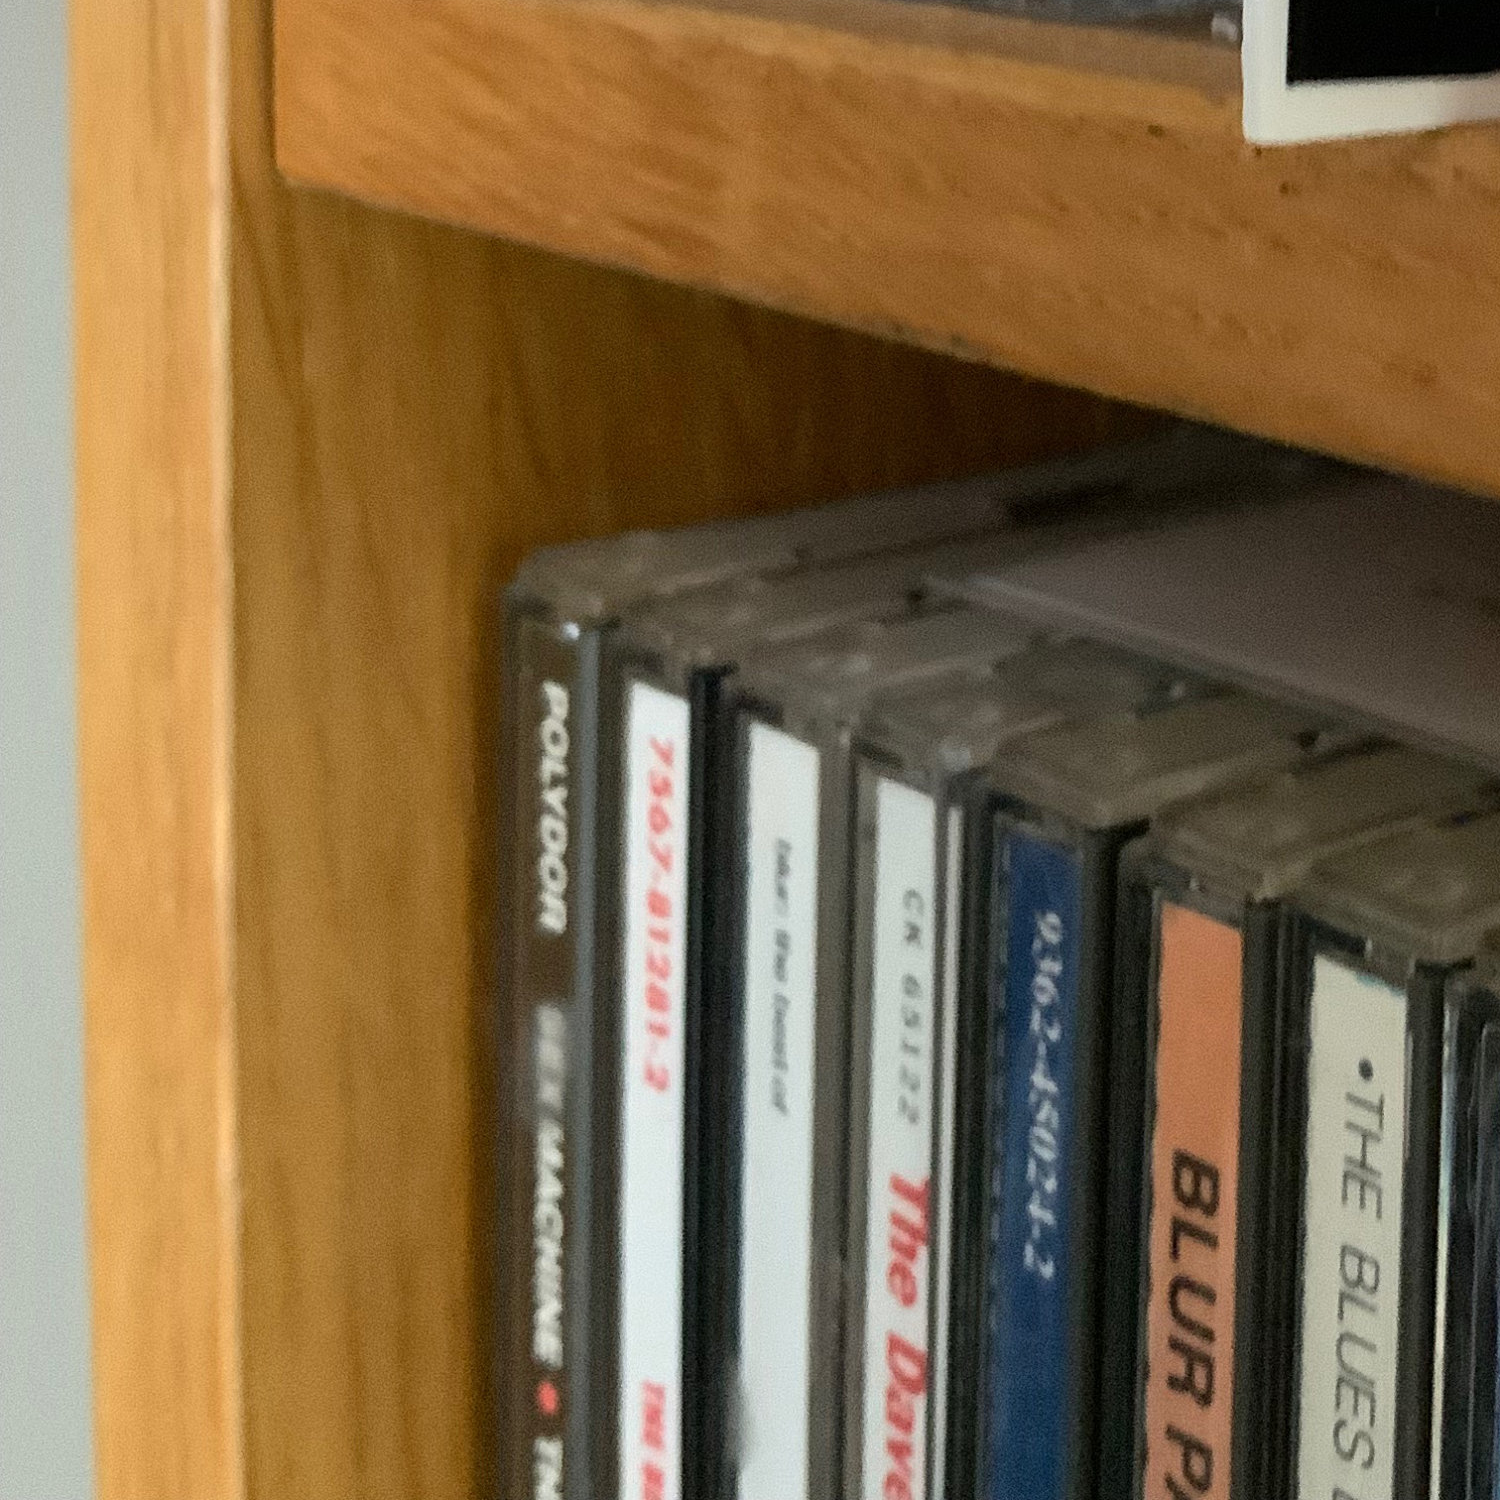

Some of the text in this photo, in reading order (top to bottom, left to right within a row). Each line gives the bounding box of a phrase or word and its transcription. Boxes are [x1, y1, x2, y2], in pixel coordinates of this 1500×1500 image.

[538, 680, 570, 937] POLYDOR
[886, 1171, 931, 1307] The
[1341, 1090, 1386, 1221] THE
[1166, 1147, 1222, 1411] BLUR
[1332, 1243, 1382, 1471] BLUES
